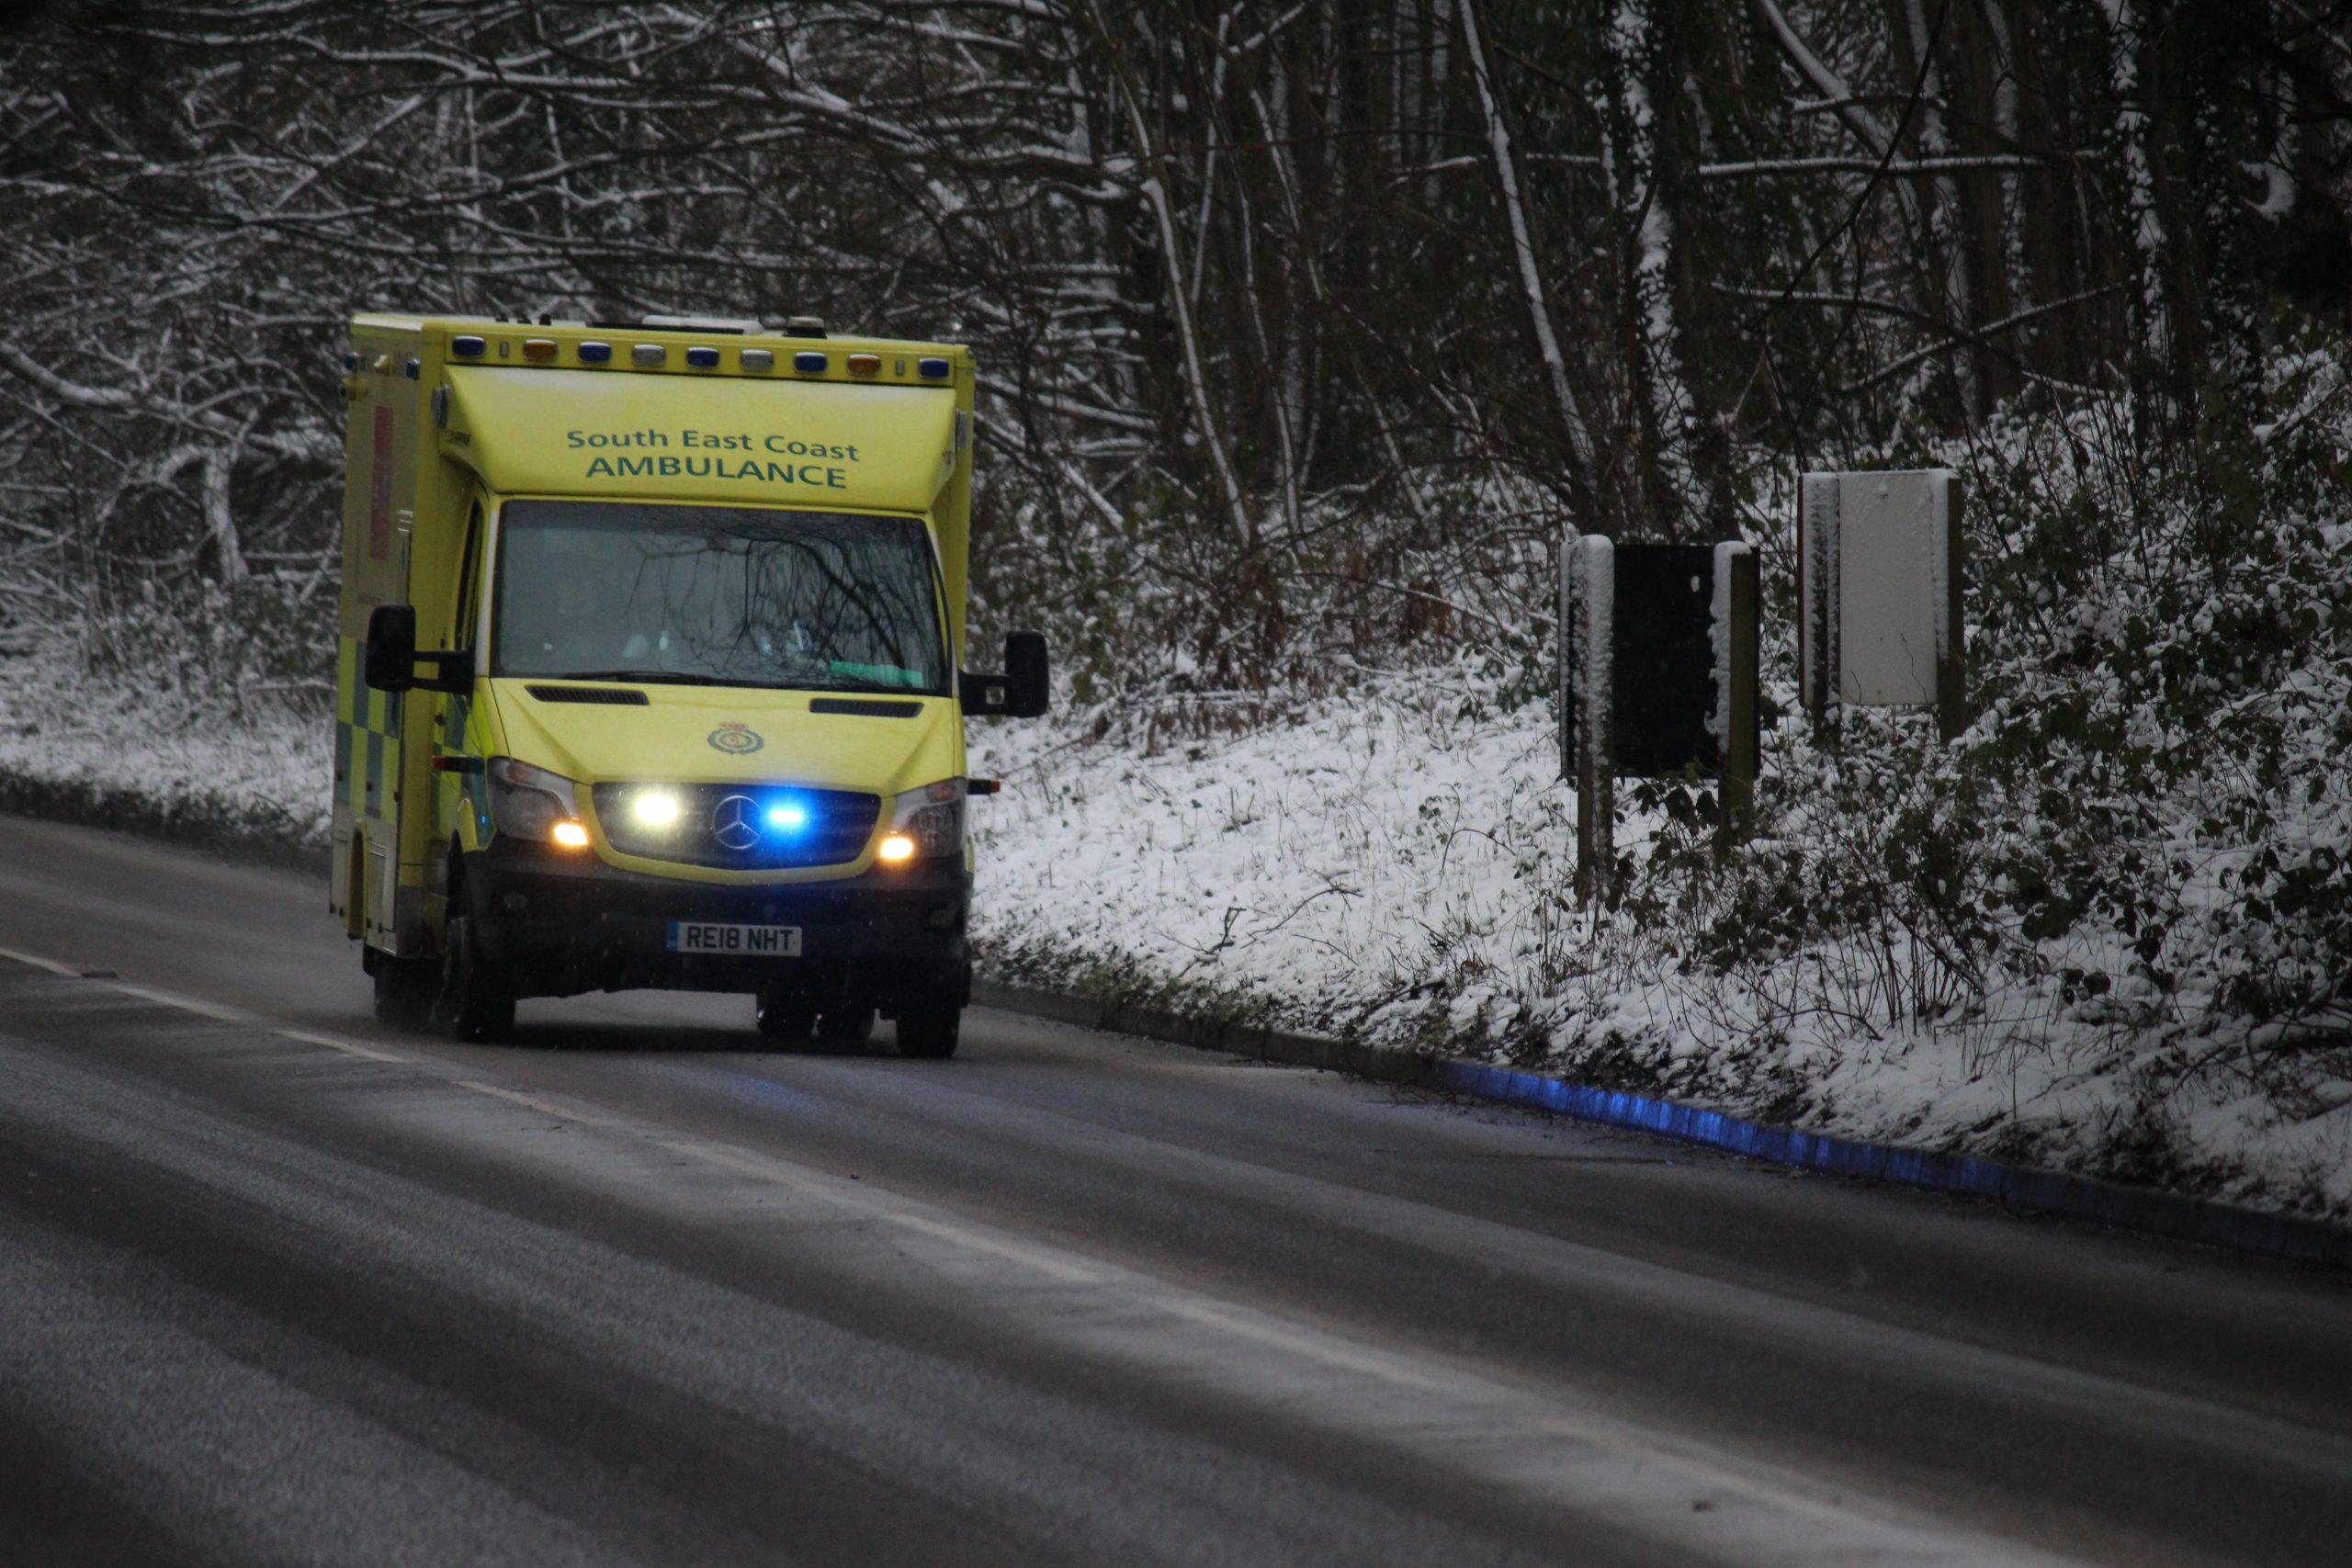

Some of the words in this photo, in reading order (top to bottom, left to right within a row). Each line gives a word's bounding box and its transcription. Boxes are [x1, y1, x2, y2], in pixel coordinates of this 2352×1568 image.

[566, 429, 669, 448] South
[683, 430, 753, 450] East
[764, 435, 860, 461] Coast
[585, 457, 847, 489] AMBULANCE
[686, 926, 741, 950] RE18
[747, 928, 794, 951] NHT
